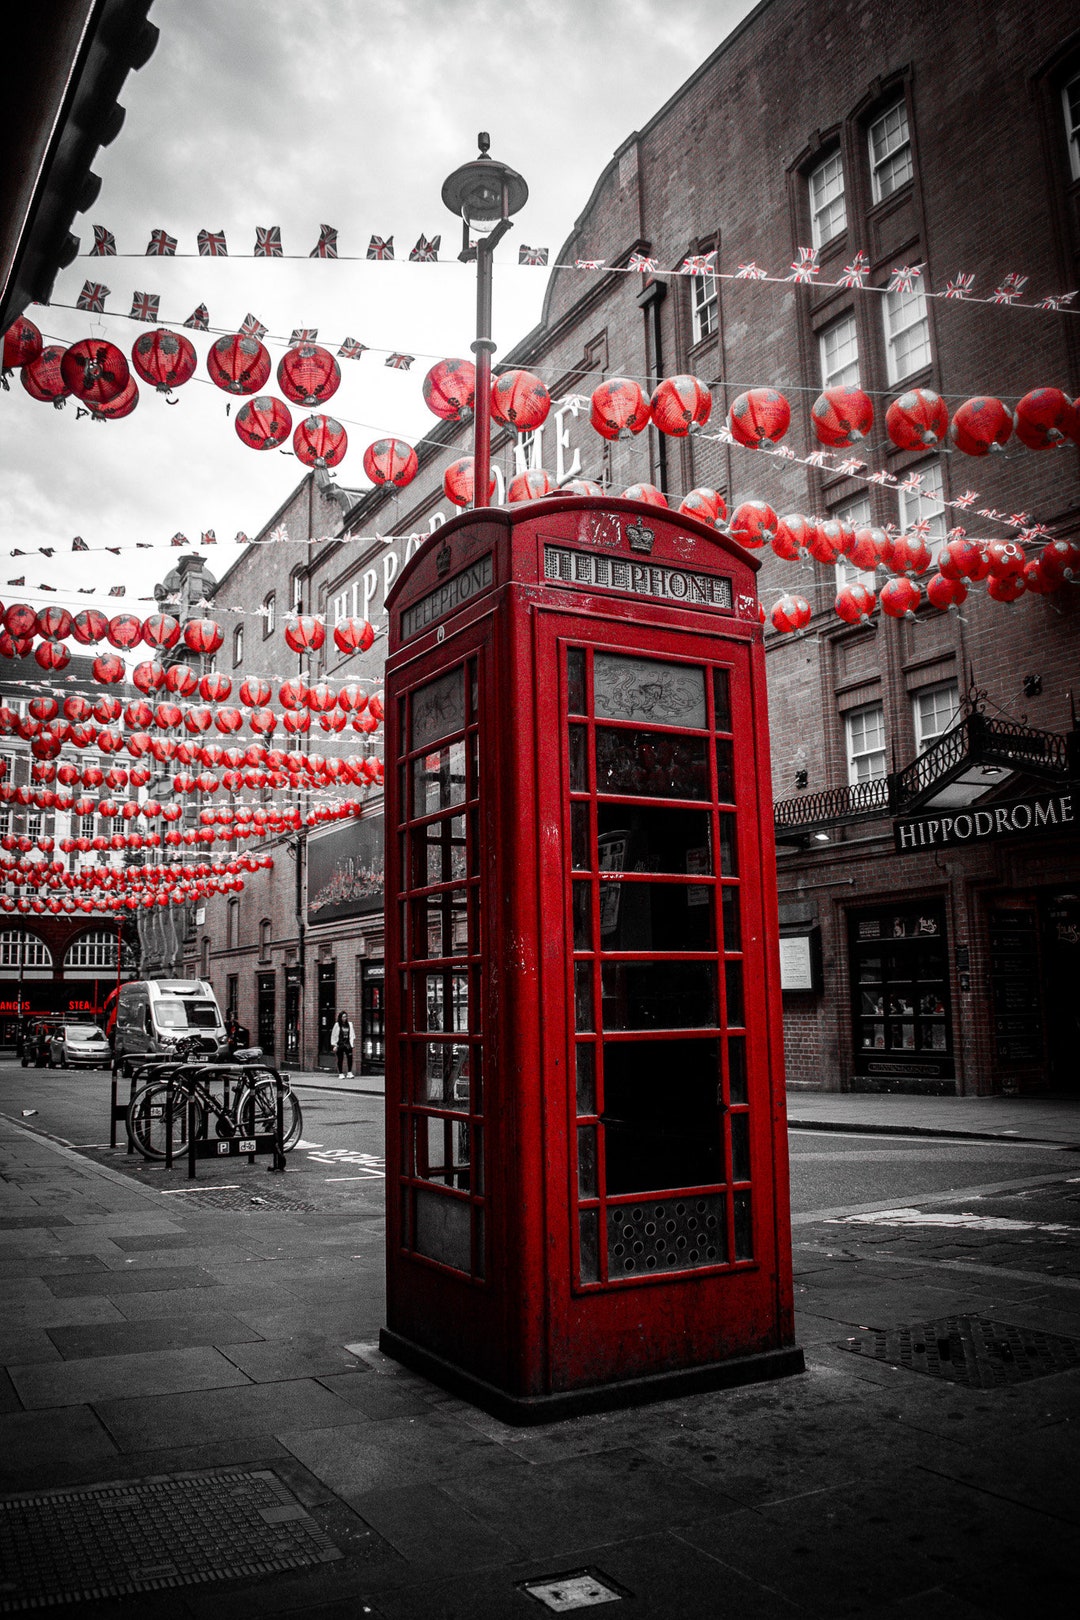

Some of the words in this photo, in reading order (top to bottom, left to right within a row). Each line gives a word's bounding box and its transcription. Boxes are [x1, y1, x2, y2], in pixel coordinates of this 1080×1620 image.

[333, 402, 582, 651] HIPPME
[406, 560, 492, 635] TELEPHONE
[554, 551, 724, 604] TELEPHONE
[899, 795, 1074, 848] HIPPODROME
[69, 1001, 93, 1010] STEA
